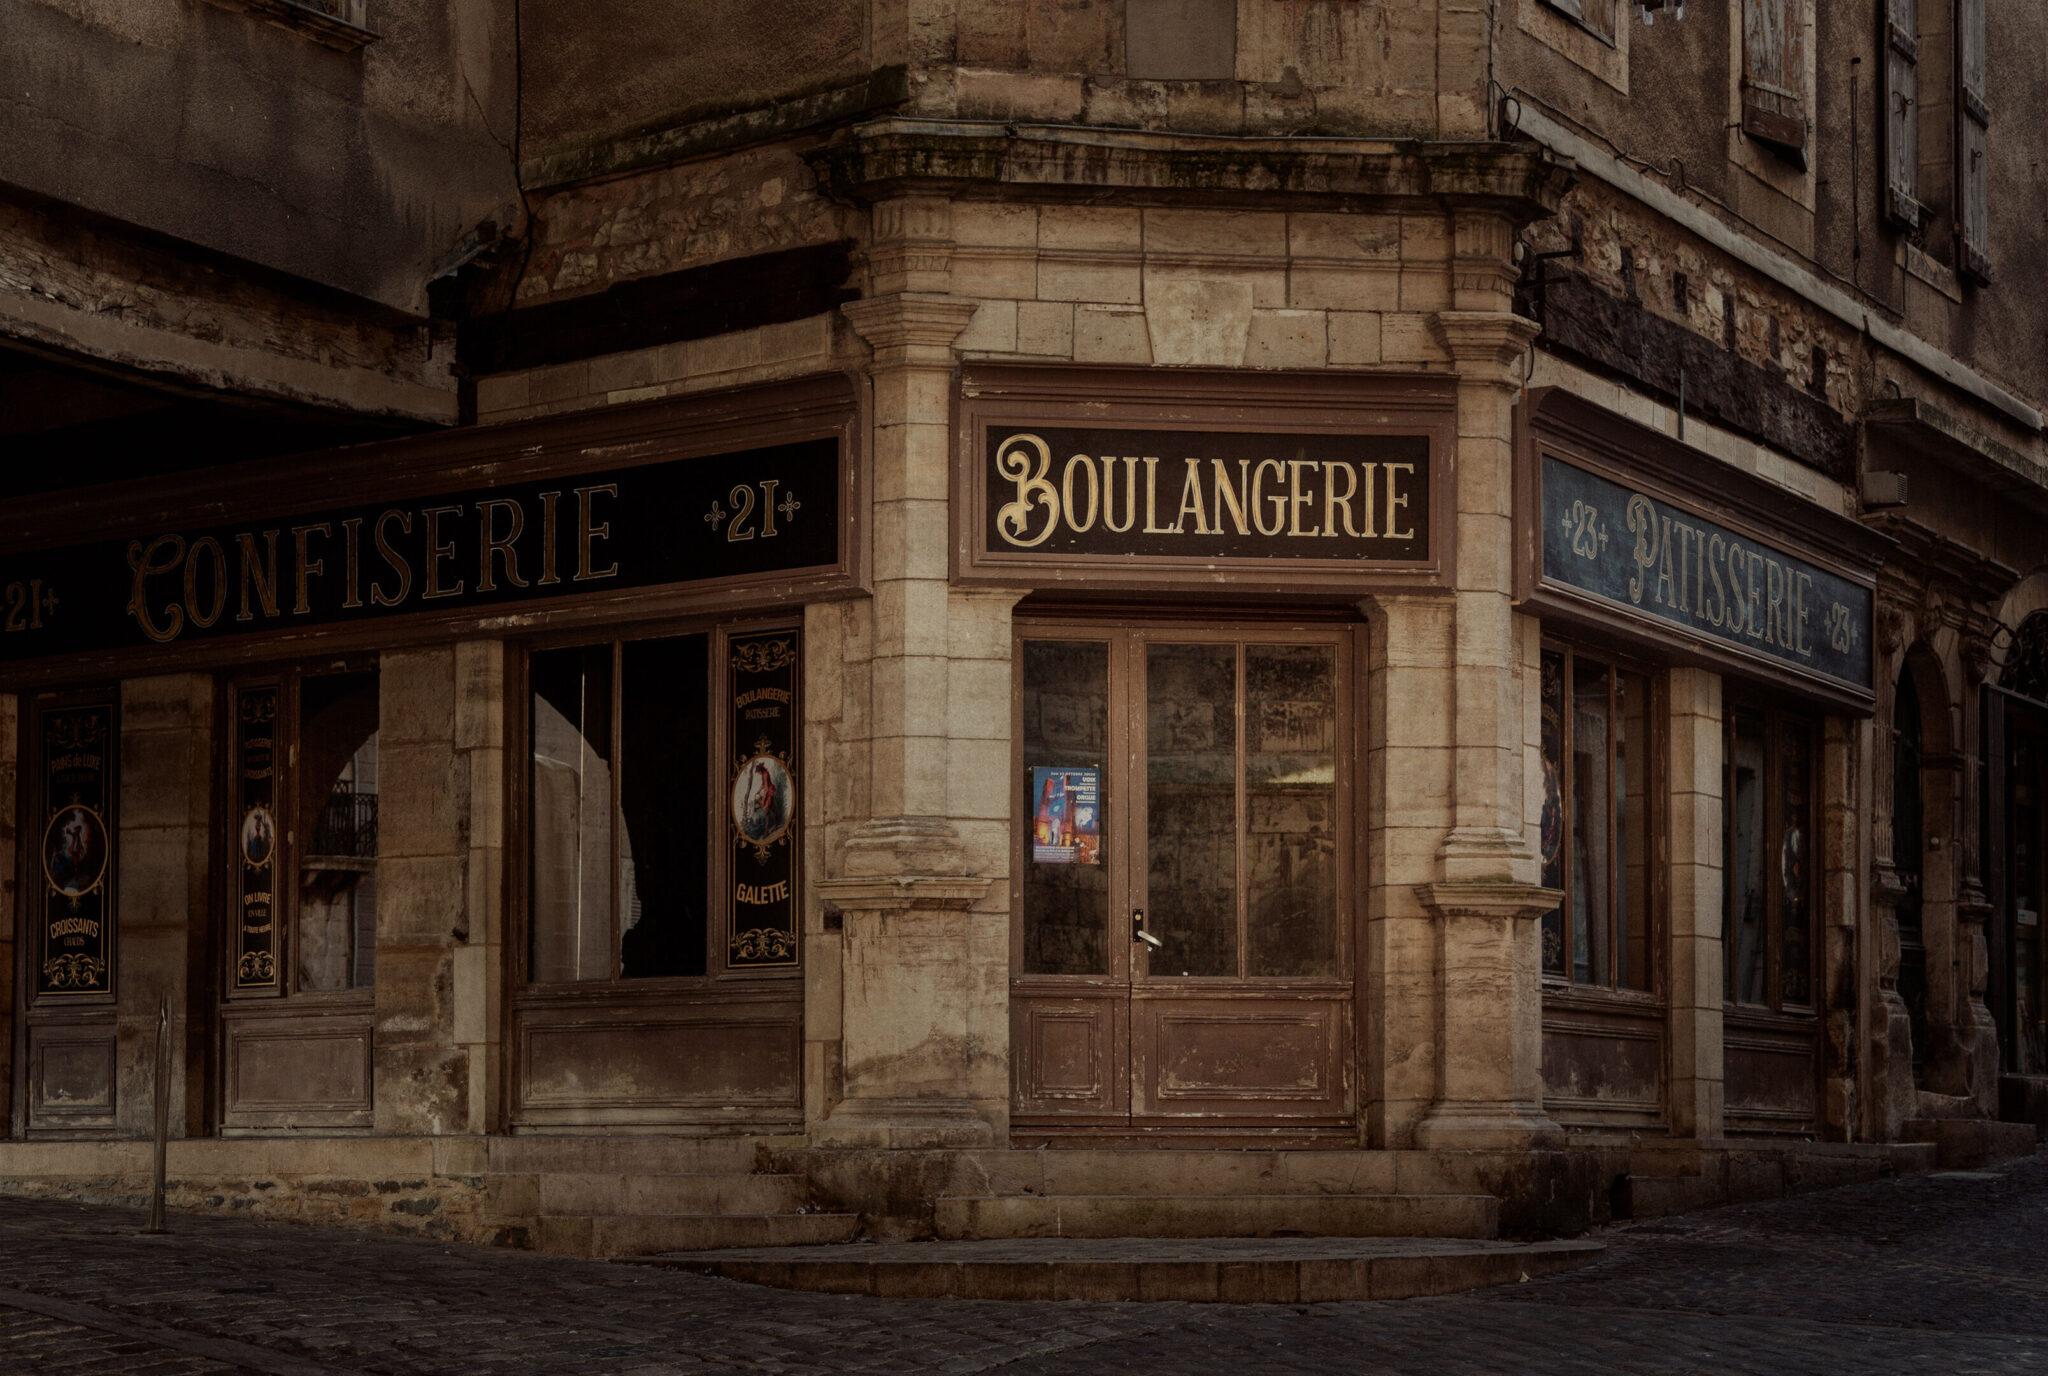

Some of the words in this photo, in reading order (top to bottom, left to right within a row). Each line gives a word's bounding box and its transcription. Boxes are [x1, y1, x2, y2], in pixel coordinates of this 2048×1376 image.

[996, 433, 1414, 547] BOULANGERIE
[5, 578, 43, 632] 21
[127, 483, 619, 642] CONFISERIE
[728, 479, 779, 542] 21
[1573, 500, 1598, 560] 23
[1627, 493, 1812, 657] PATISSERIE
[1831, 602, 1850, 654] 23
[736, 687, 791, 709] BOULANGERIE
[736, 880, 789, 904] GALETTE
[50, 917, 99, 939] CROISSANTS
